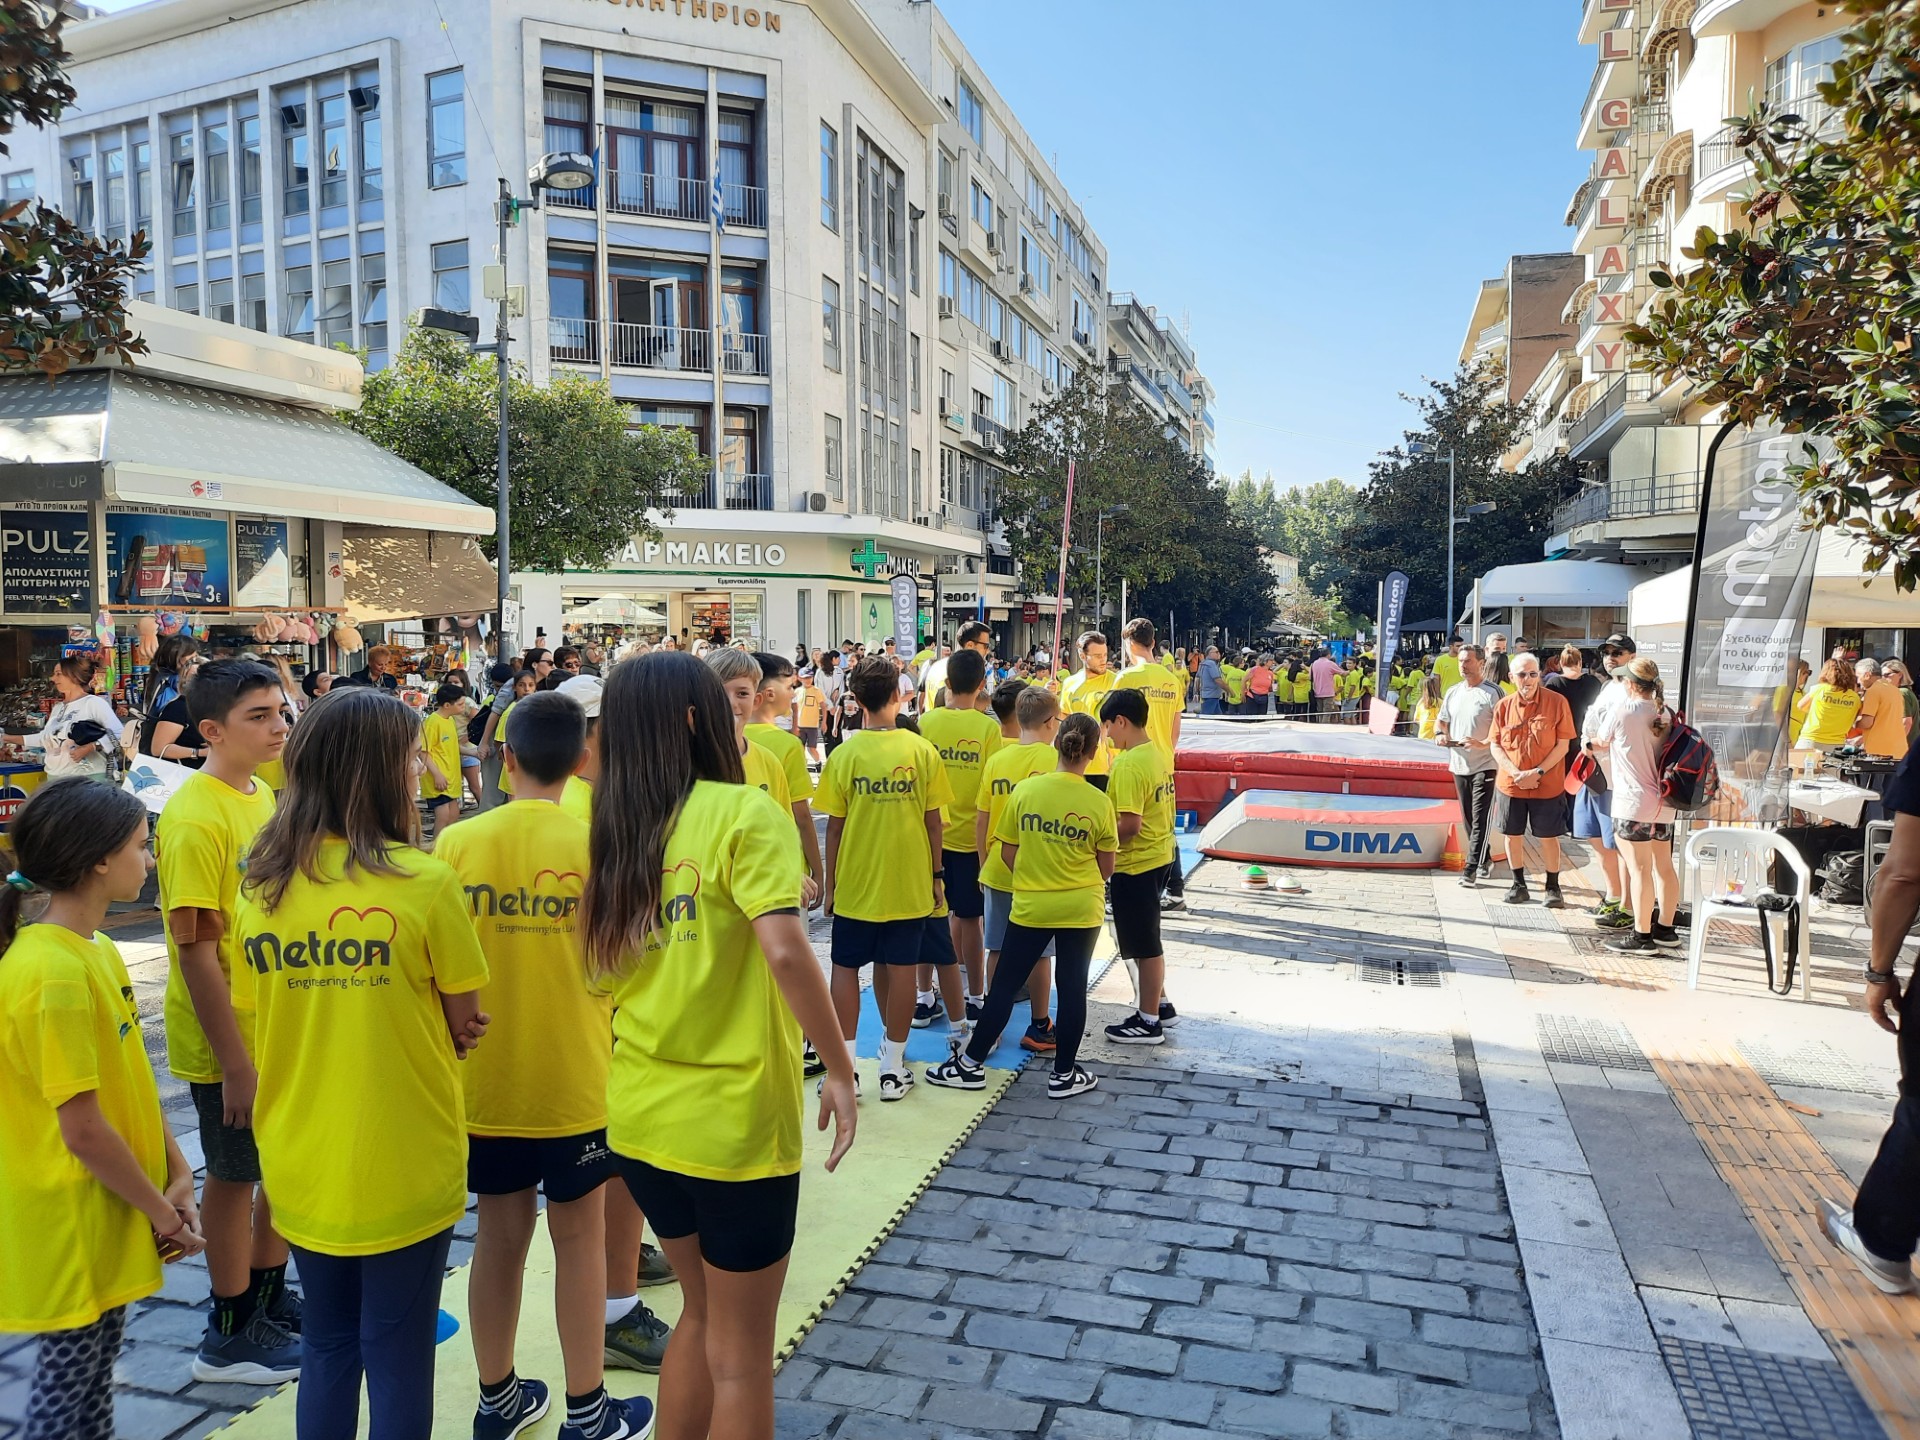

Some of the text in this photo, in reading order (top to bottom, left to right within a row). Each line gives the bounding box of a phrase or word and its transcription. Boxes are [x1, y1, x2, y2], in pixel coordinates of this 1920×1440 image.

[1595, 102, 1629, 370] GALAXY
[69, 475, 87, 488] UP
[237, 524, 278, 537] PULZE
[610, 540, 787, 566] ΑΡΜΑΚΕΙΟ
[4, 568, 81, 578] ΑΠΟΛΑΥΣΤΙΚΗ
[4, 579, 90, 588] ΛΙΓΟΤΕΡΗ ΜΥΡΩ
[1021, 813, 1089, 842] Metron
[1305, 829, 1422, 854] DIMA
[244, 930, 390, 975] Metron
[351, 975, 366, 987] for
[370, 974, 391, 987] Life
